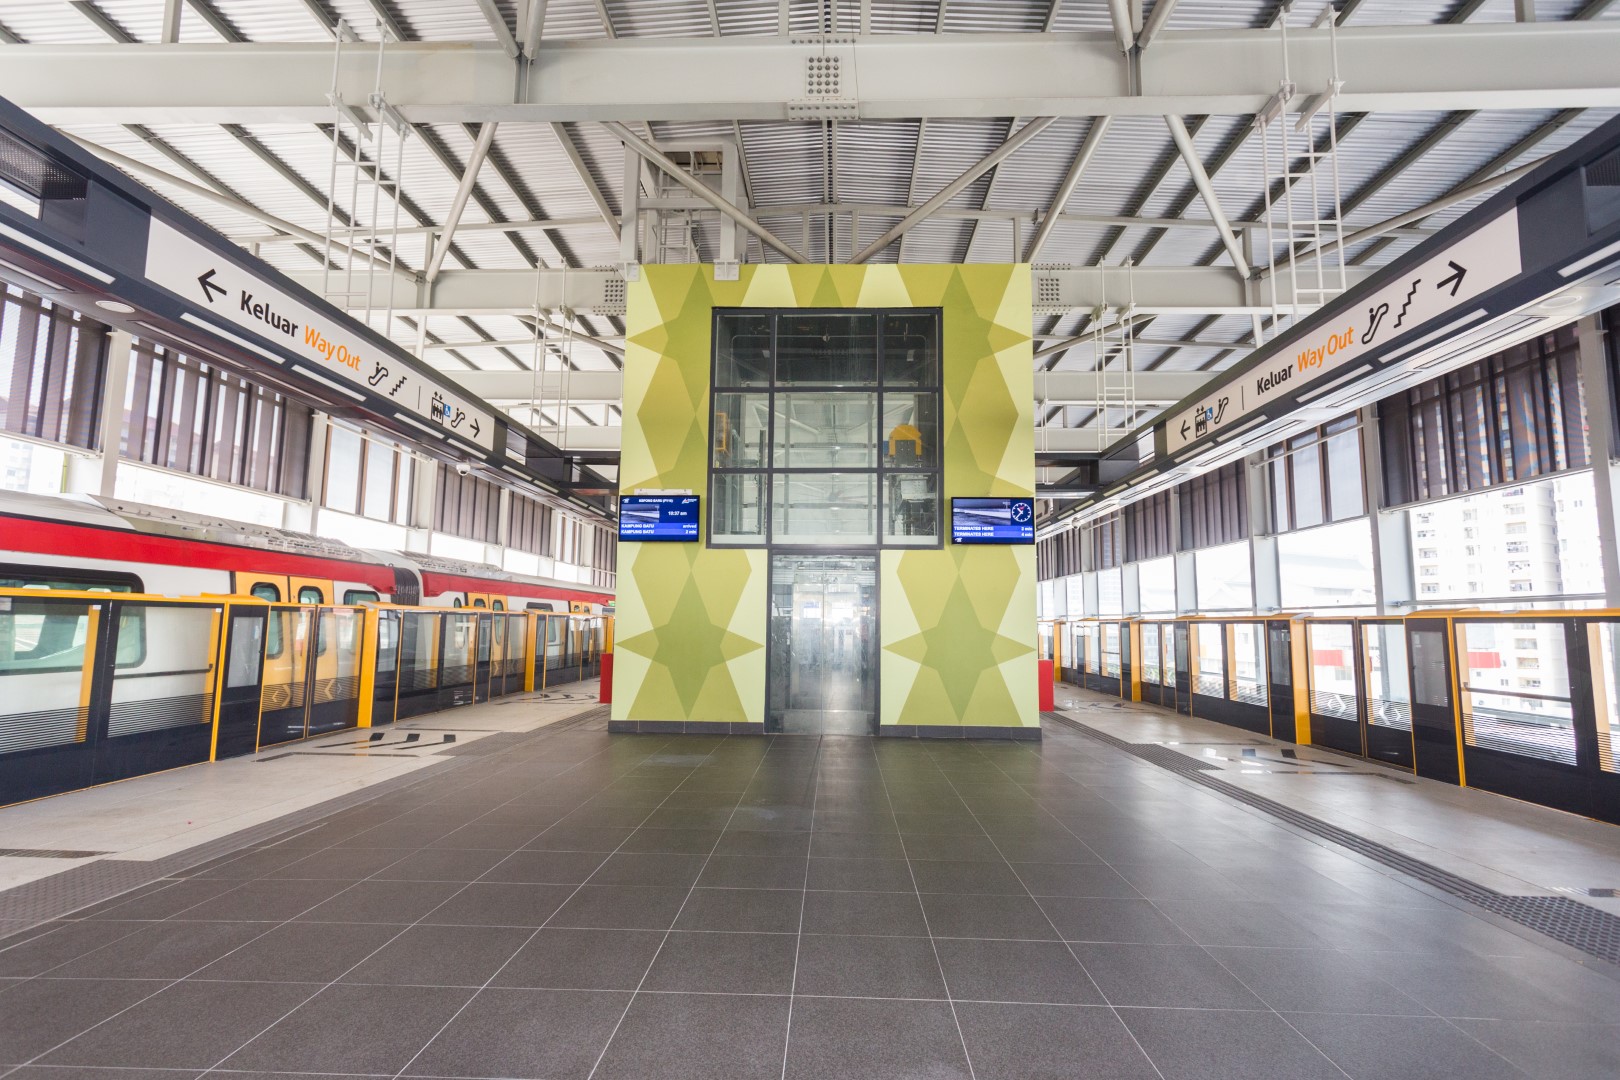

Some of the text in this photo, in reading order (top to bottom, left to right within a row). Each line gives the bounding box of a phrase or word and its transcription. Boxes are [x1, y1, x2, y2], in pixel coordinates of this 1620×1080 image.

[240, 290, 362, 372] Keluar Way Out
[1256, 326, 1355, 396] Keluar Way Out
